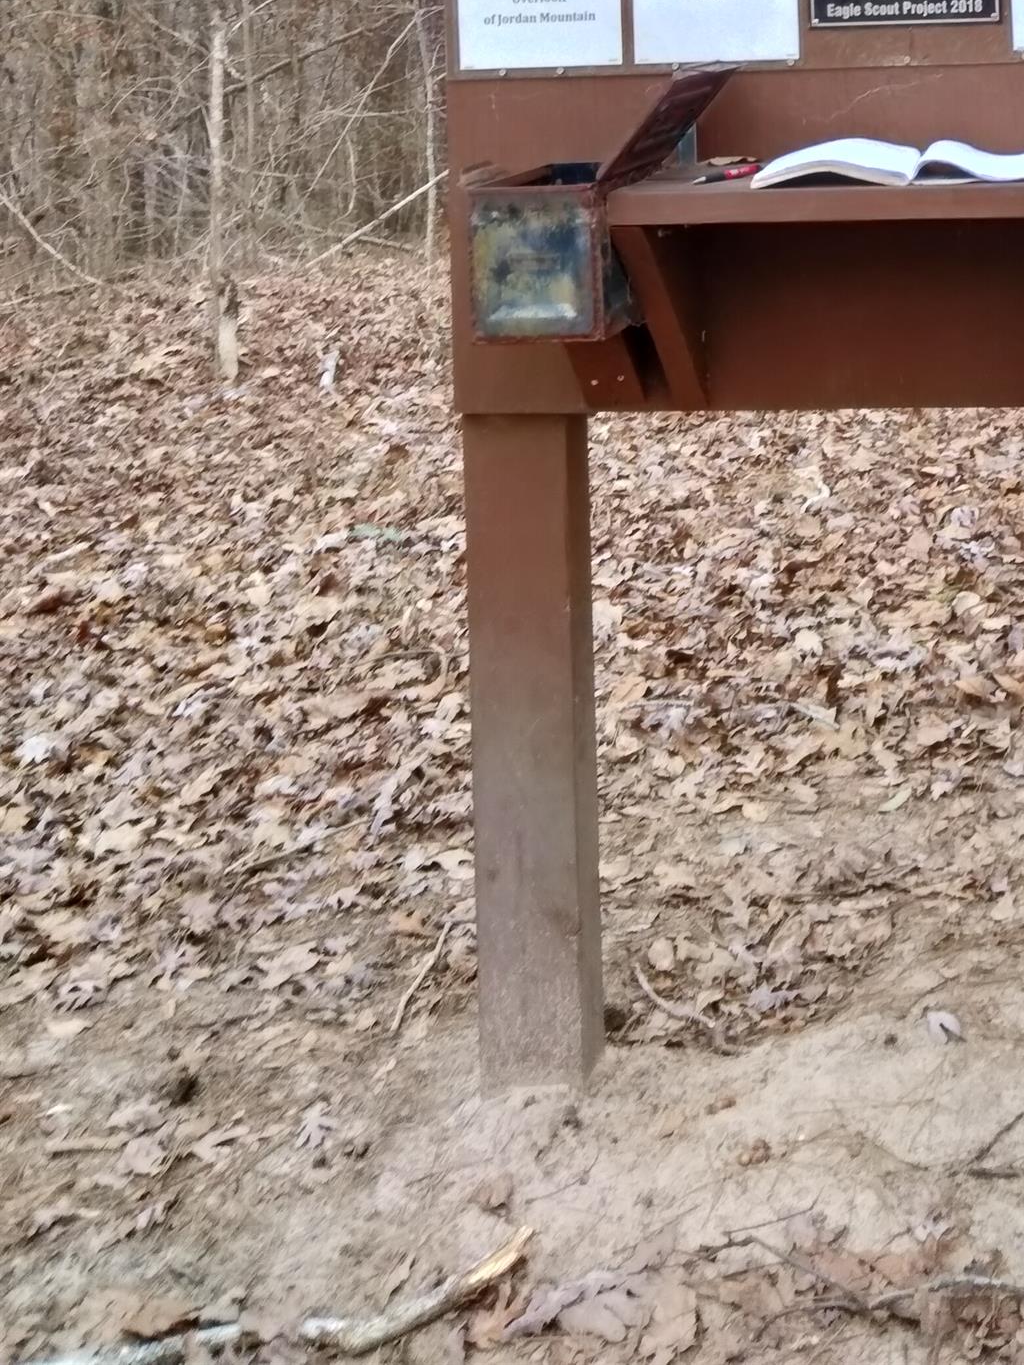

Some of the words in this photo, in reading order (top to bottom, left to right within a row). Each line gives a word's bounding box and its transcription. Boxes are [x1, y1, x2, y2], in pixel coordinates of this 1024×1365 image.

[827, 3, 861, 19] Eagle
[864, 2, 899, 15] Scout
[903, 0, 947, 17] Project
[951, 0, 983, 13] 2018
[484, 14, 495, 25] of
[497, 13, 537, 26] Jordan
[539, 11, 596, 24] Mountain
